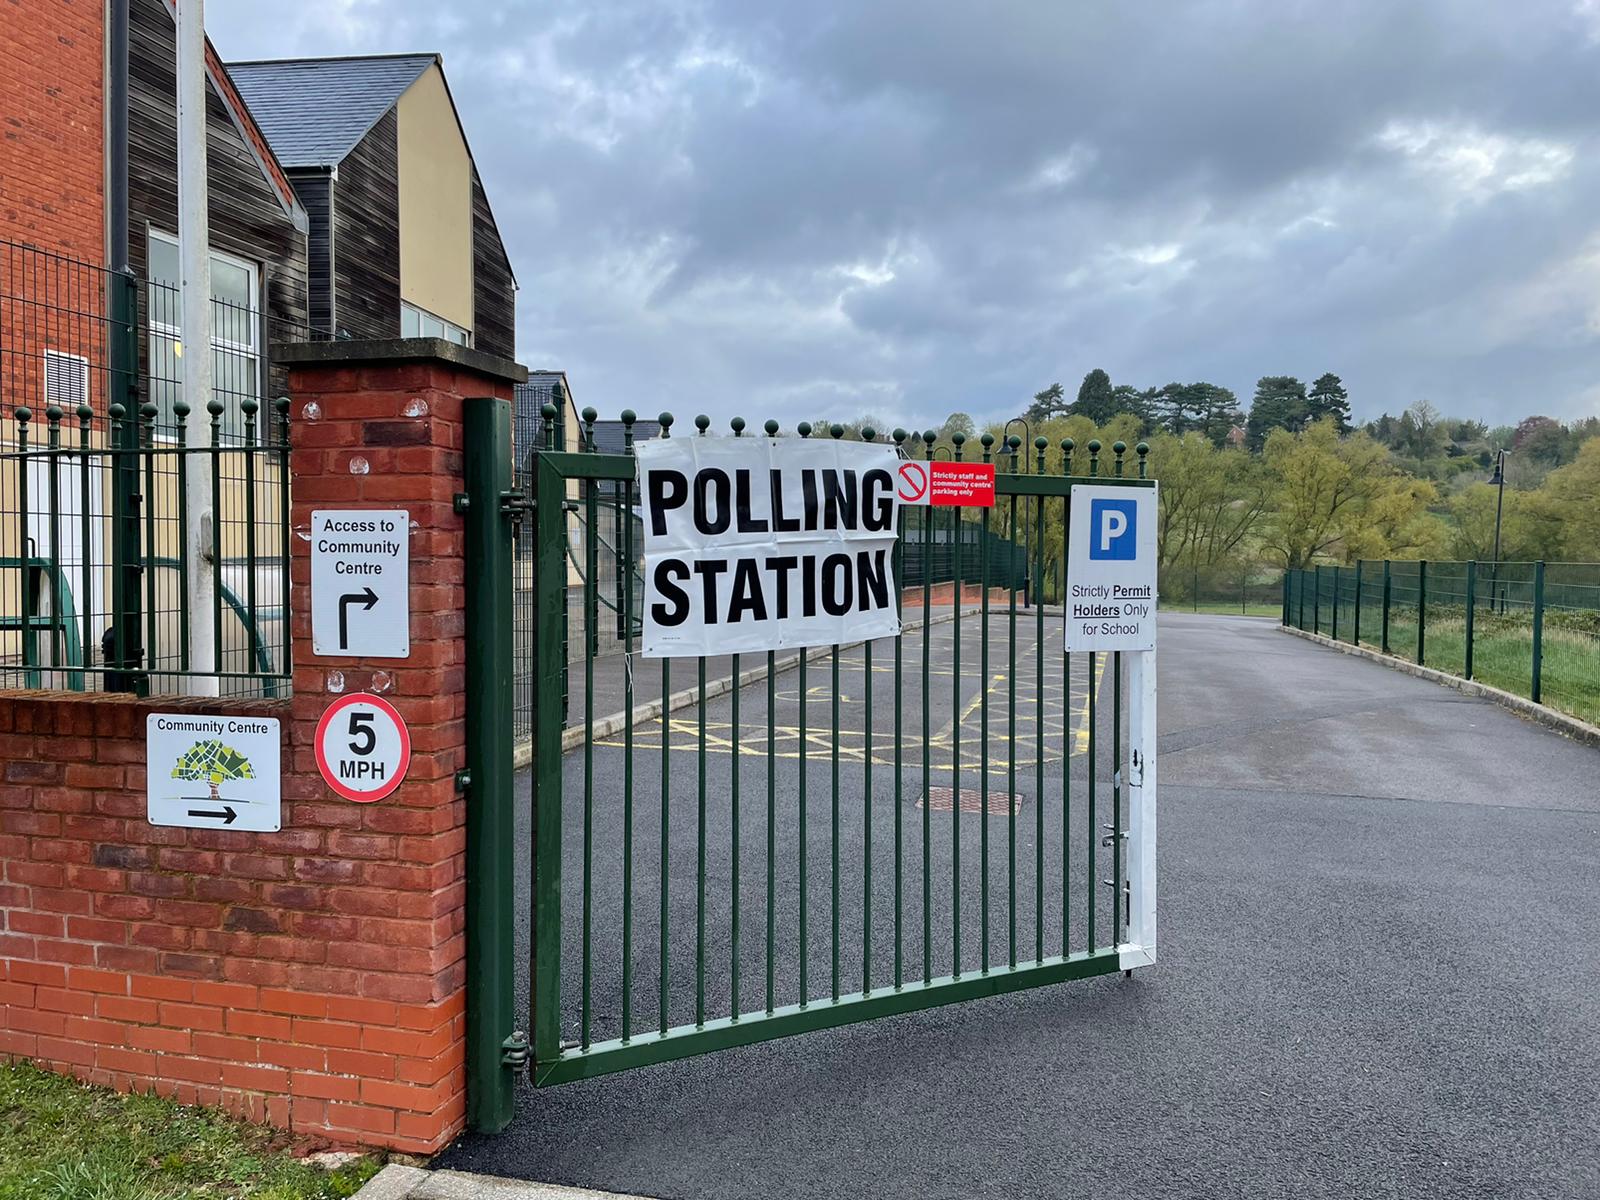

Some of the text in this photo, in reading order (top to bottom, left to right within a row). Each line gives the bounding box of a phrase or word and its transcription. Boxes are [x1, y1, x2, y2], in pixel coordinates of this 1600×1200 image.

[932, 472, 957, 480] Strictly
[932, 480, 969, 488] community
[932, 488, 958, 496] parking
[648, 468, 894, 536] POLLING
[323, 519, 395, 532] Access to
[1101, 509, 1127, 550] P
[318, 540, 400, 557] Community
[335, 561, 382, 575] Centre
[651, 550, 889, 627] STATION
[1072, 585, 1151, 599] Strictly Permit
[1073, 603, 1149, 618] Holders Only
[1082, 623, 1139, 635] for School
[157, 719, 268, 735] Community Centre
[348, 712, 376, 756] 5
[339, 760, 385, 780] MPH
